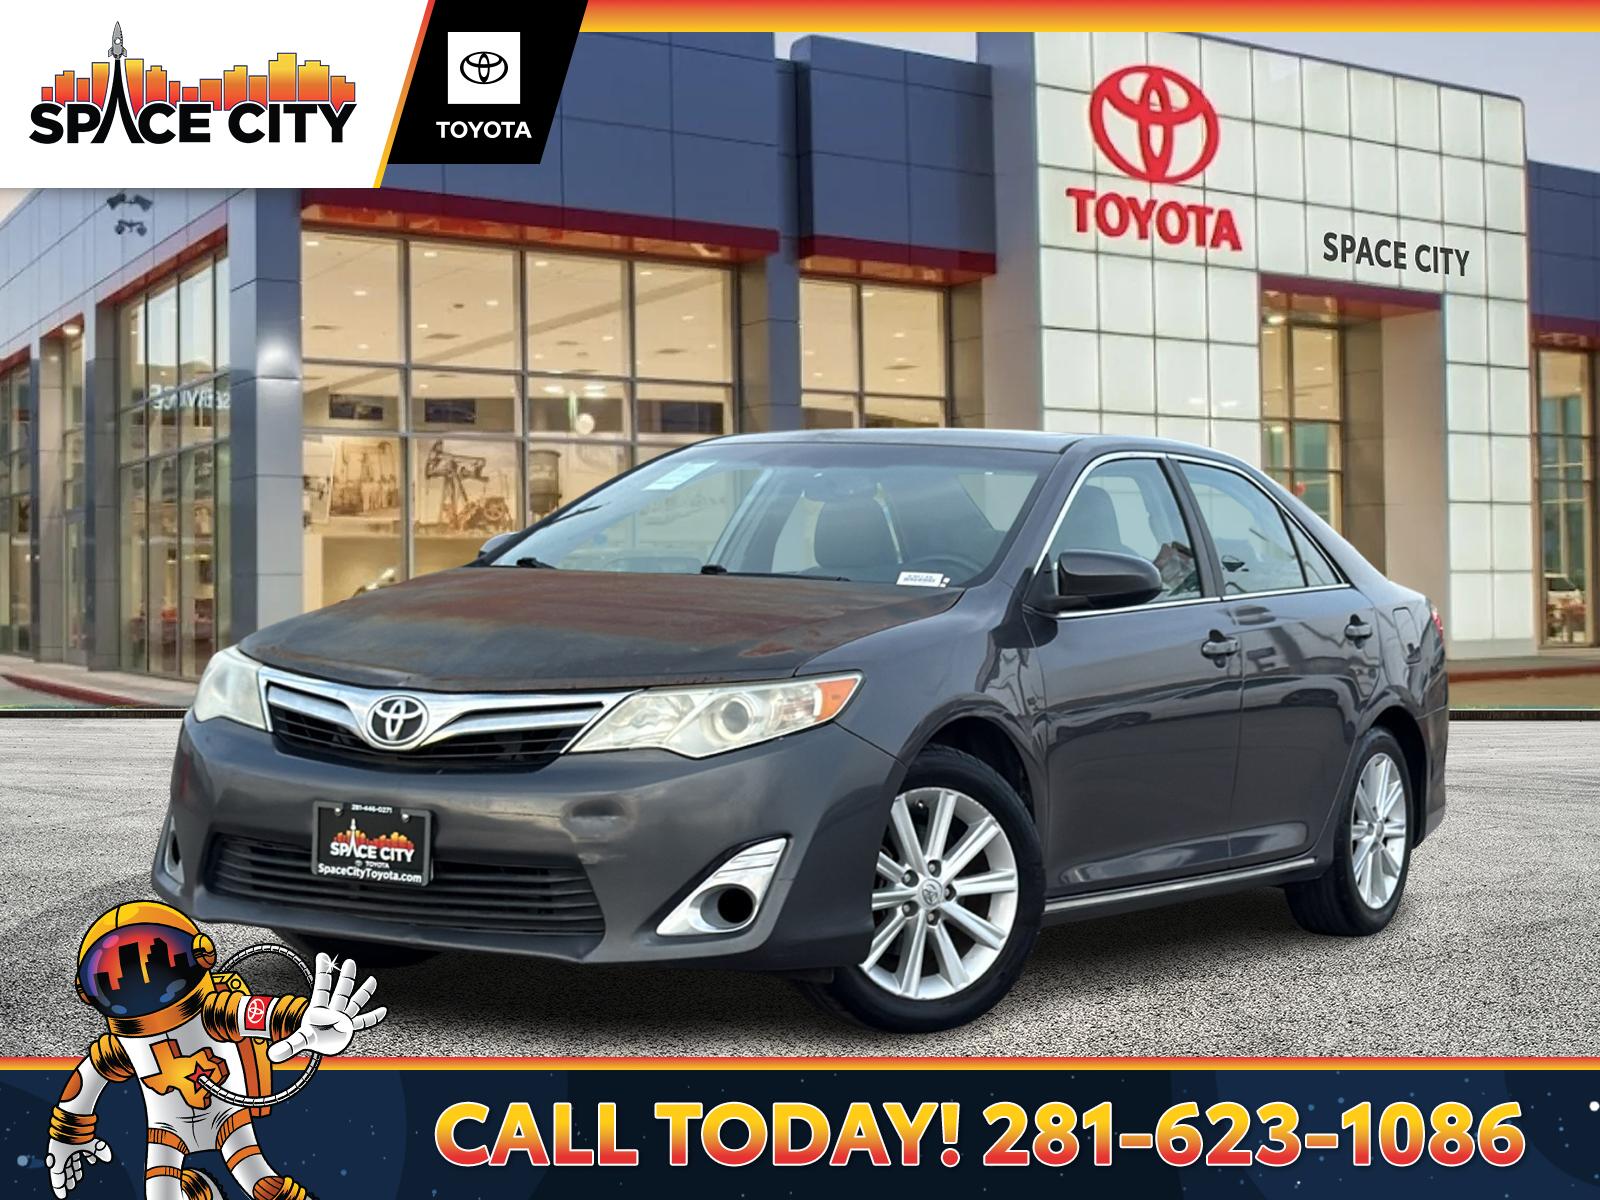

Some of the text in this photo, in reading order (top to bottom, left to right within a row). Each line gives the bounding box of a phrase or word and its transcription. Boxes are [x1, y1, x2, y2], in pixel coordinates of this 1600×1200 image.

[1065, 187, 1243, 251] TOYOTA
[1322, 231, 1470, 277] SPACE CITY
[330, 841, 415, 862] SPACE CITY
[318, 863, 422, 883] SpaceCityToyota.com
[365, 860, 390, 869] TOYOTA
